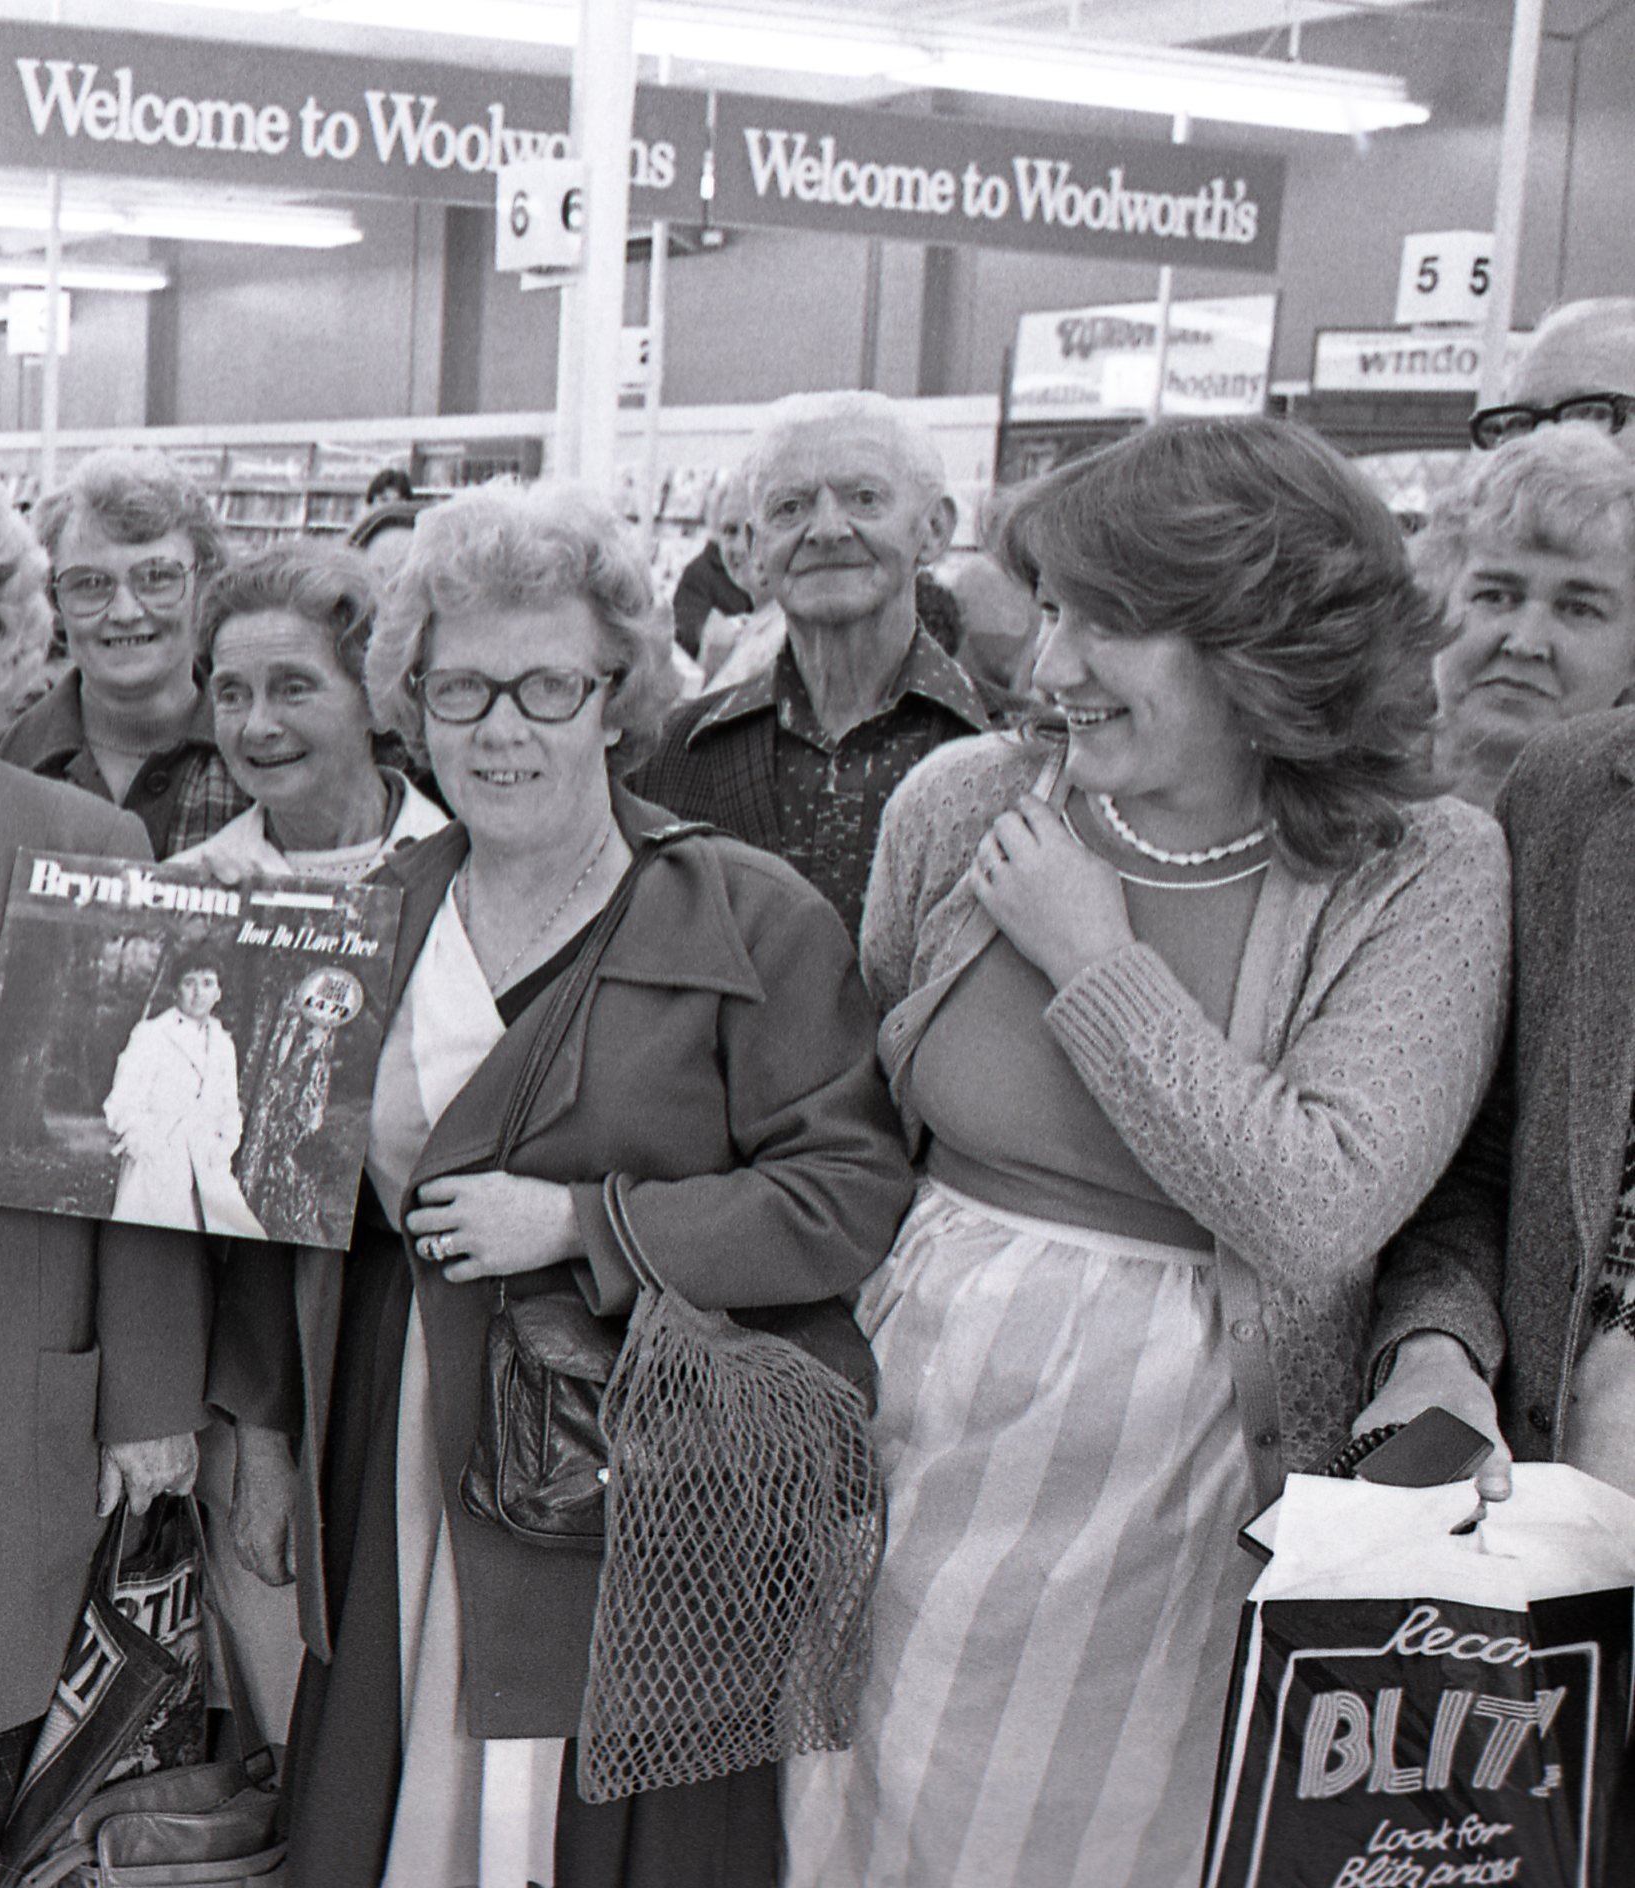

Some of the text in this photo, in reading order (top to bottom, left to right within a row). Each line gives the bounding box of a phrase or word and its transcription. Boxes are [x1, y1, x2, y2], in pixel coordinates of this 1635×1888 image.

[15, 57, 290, 154] Welcome
[299, 96, 360, 160] to
[744, 128, 1258, 243] Welcome to Woolworth's
[1416, 256, 1490, 296] 5 5
[1359, 345, 1480, 376] windo
[29, 858, 242, 917] Bryn Yemm
[236, 919, 272, 945] How
[270, 924, 294, 947] Do
[302, 927, 341, 952] Love
[340, 930, 379, 957] Thee
[1367, 1812, 1514, 1853] Look for
